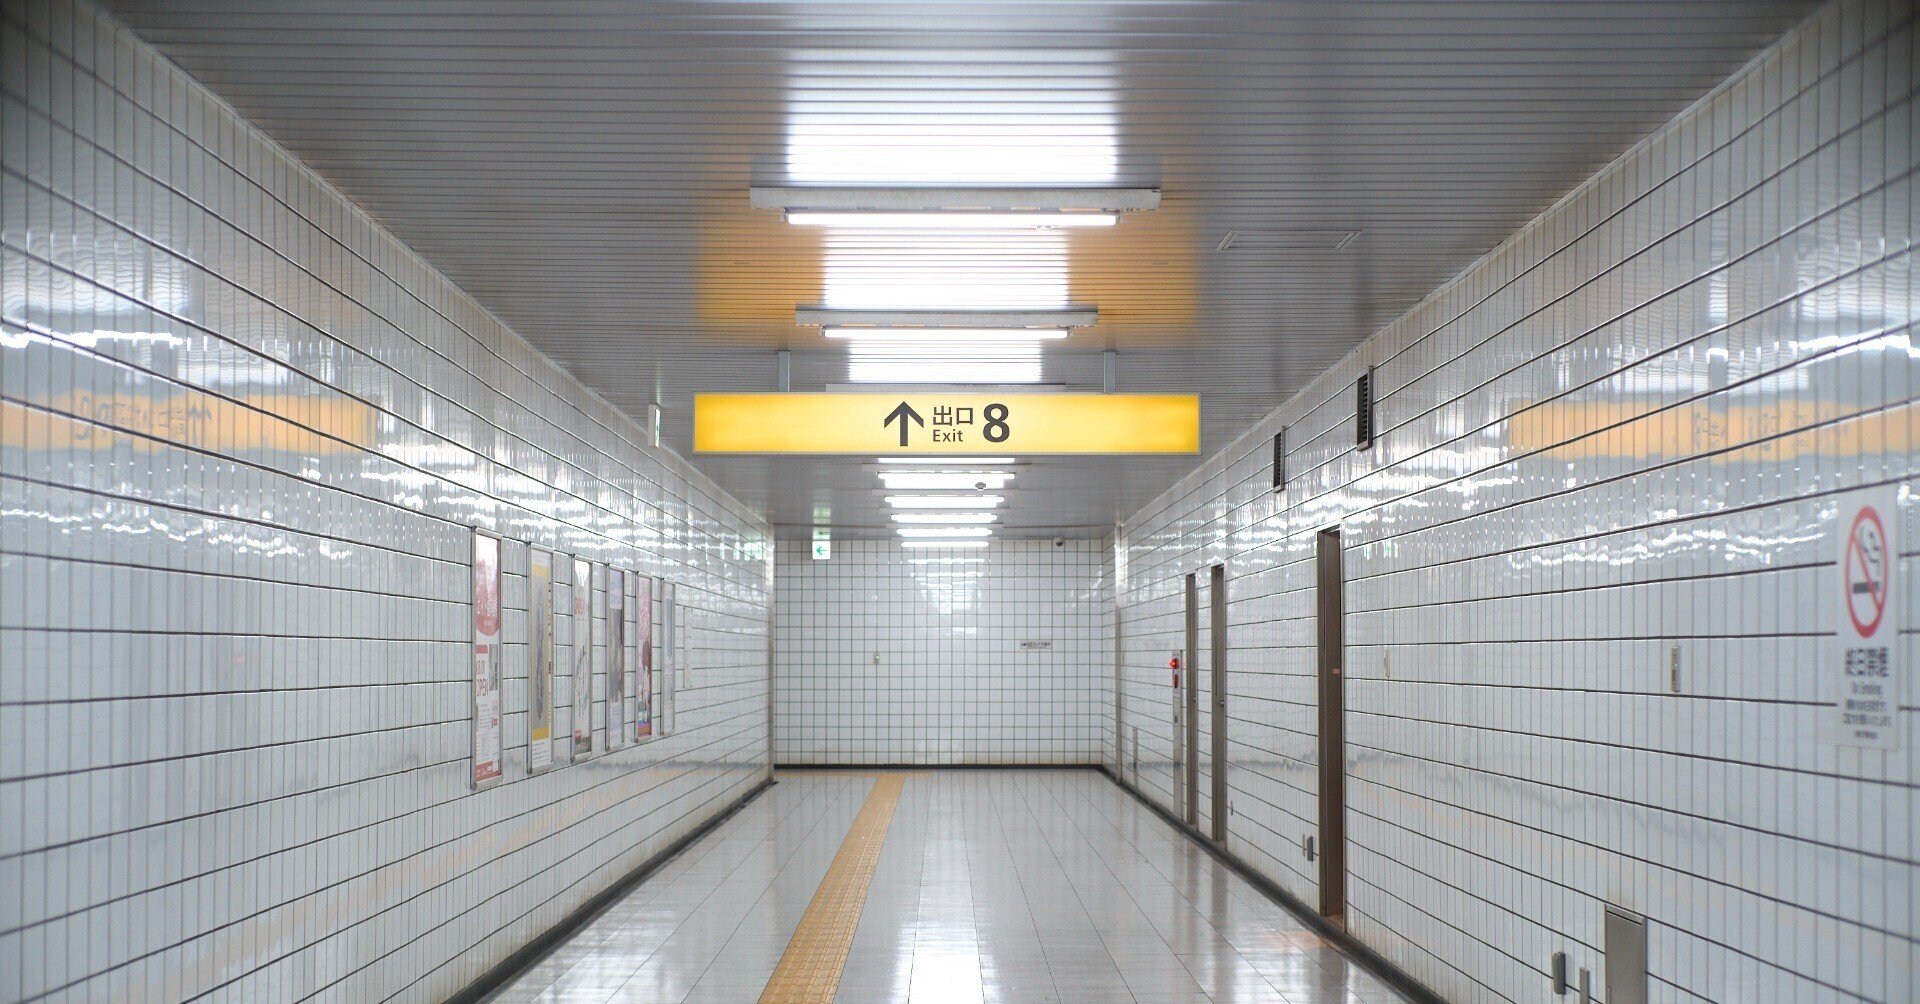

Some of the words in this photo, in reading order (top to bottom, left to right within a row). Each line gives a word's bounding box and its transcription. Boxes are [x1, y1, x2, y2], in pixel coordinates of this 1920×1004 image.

[932, 429, 964, 442] Exit
[933, 405, 973, 426] 出口
[982, 403, 1010, 443] 8
